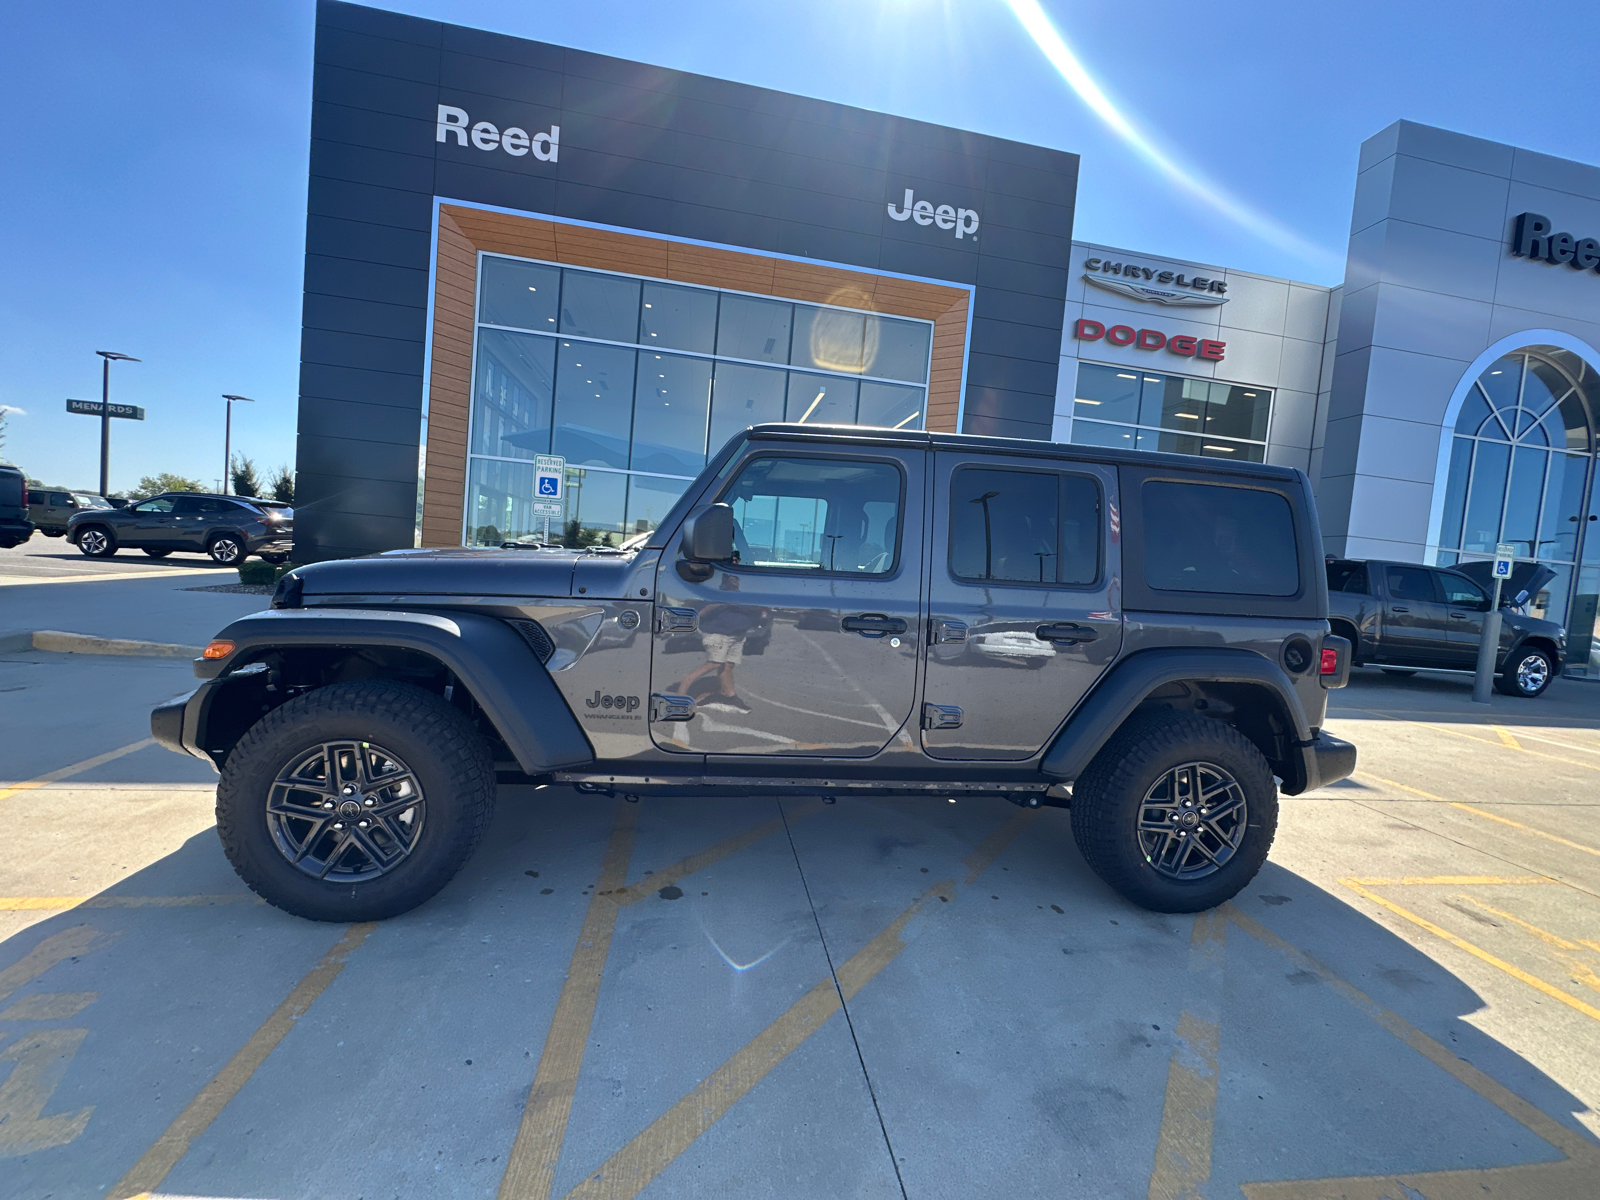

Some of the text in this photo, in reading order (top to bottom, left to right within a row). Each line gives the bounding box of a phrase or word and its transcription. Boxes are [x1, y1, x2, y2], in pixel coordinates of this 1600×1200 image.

[436, 104, 560, 163] Reed
[887, 188, 979, 239] Jeep
[1512, 211, 1600, 274] Ree
[1085, 258, 1228, 293] CHRYSLER
[1075, 318, 1226, 361] DODGE
[537, 465, 562, 474] PARKING
[538, 458, 562, 466] RESERVED
[585, 690, 640, 713] Jeep
